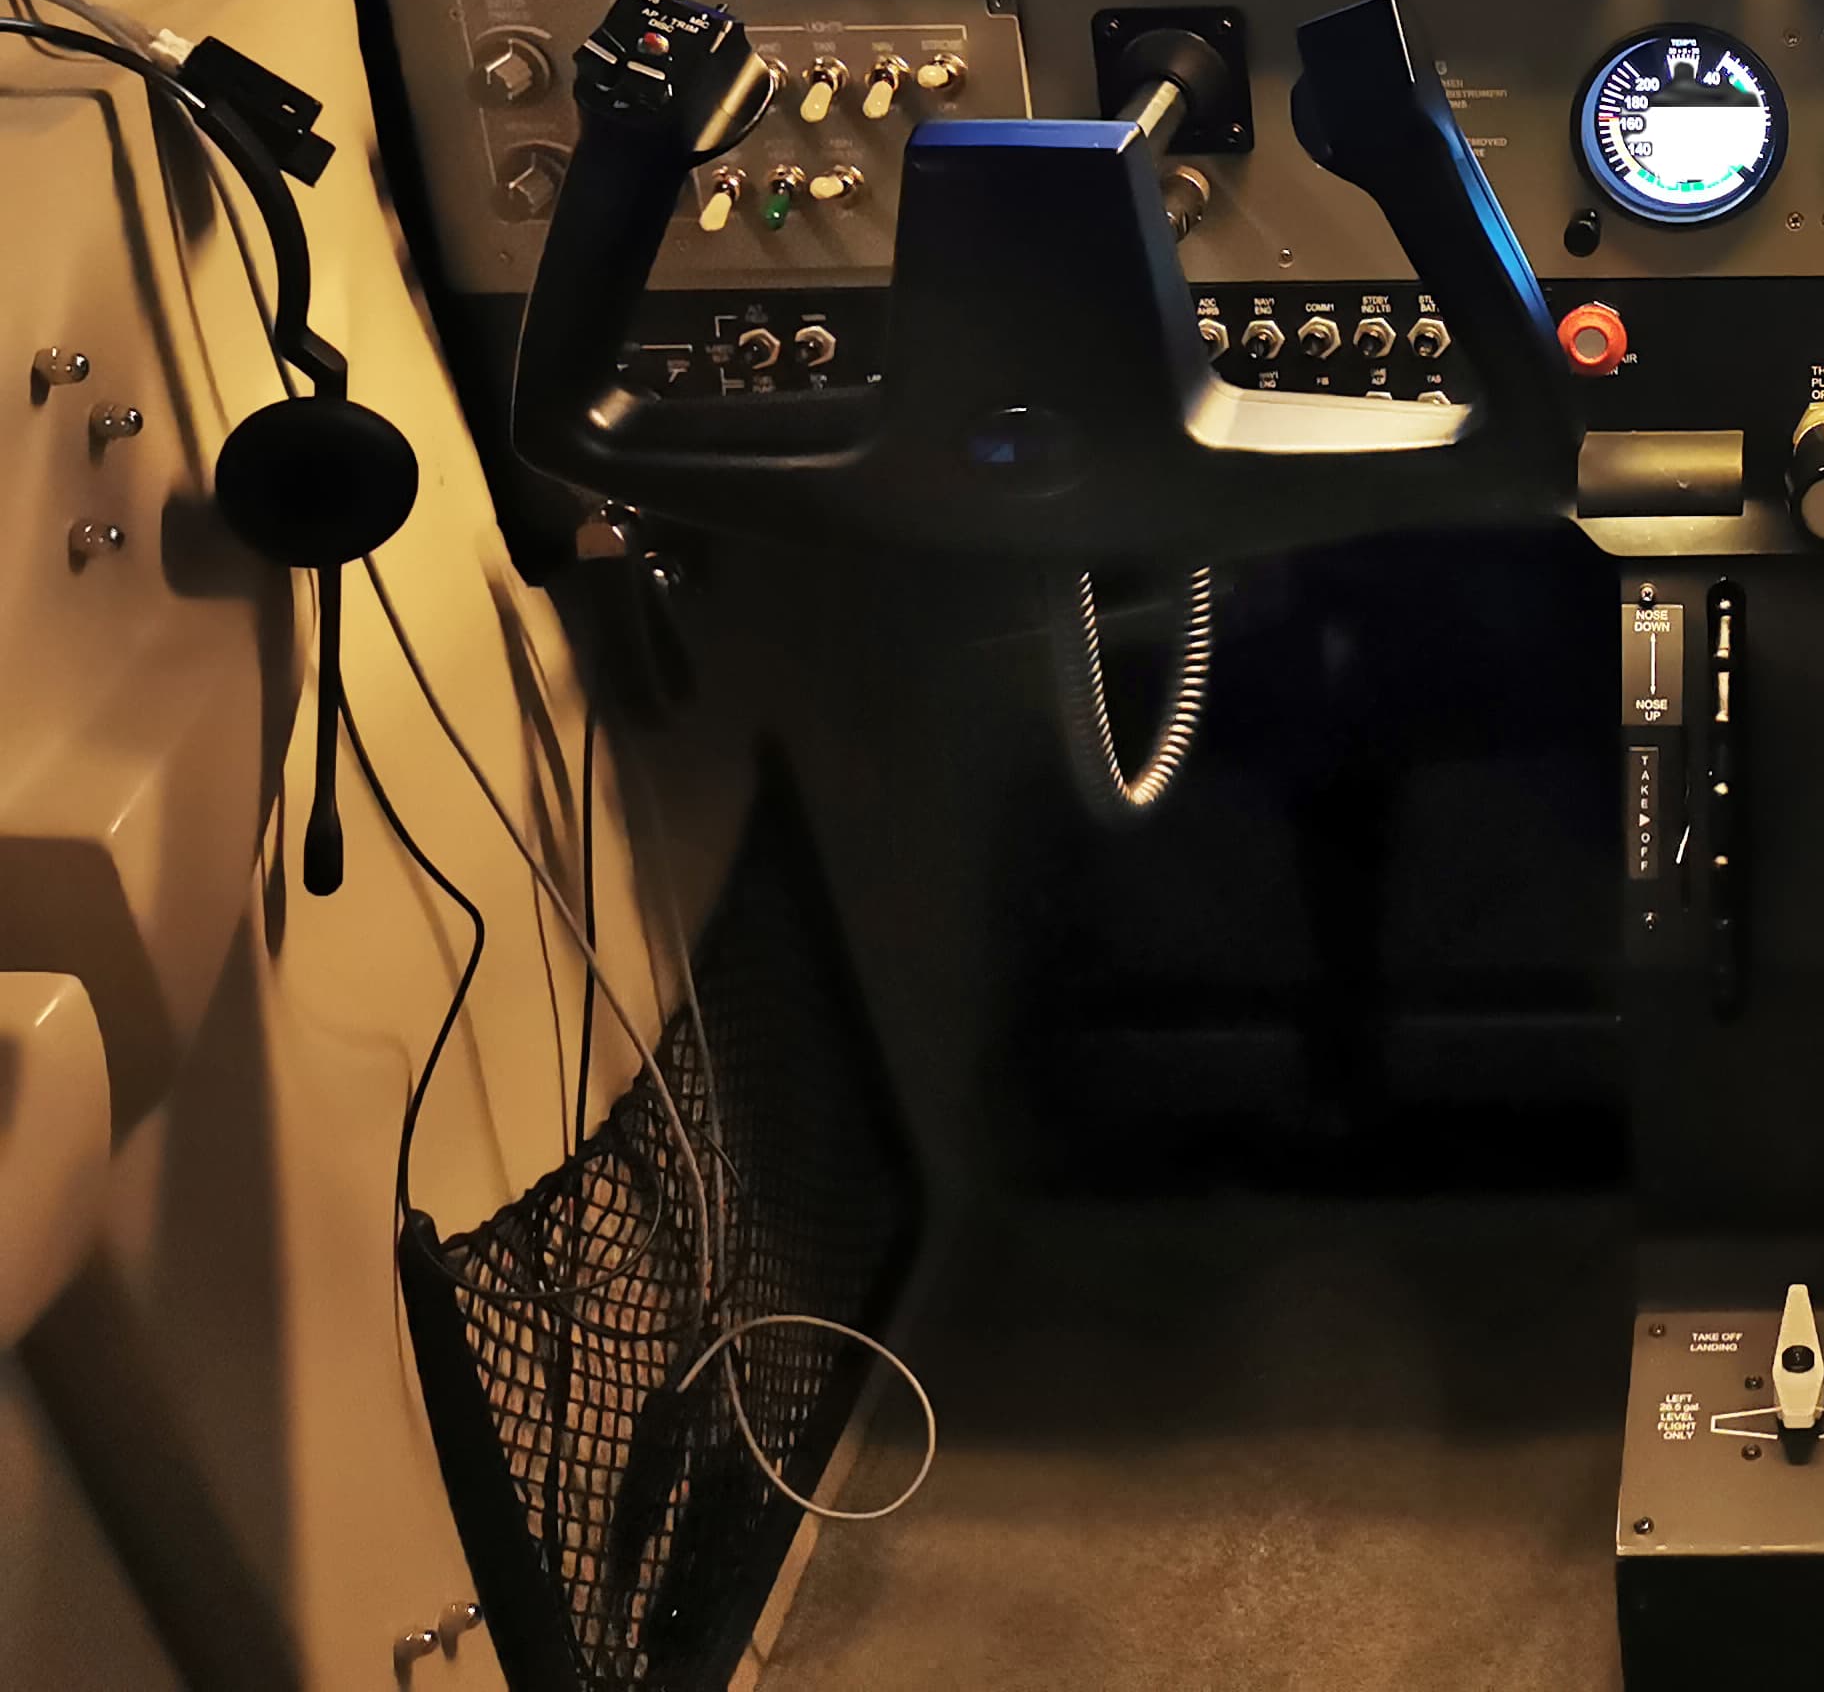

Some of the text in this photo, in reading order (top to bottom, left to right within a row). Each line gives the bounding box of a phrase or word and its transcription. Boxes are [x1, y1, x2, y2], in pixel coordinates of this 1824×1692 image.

[642, 8, 699, 33] AP TRIM
[690, 16, 710, 29] MIC
[648, 20, 674, 33] DISC
[1635, 77, 1660, 91] 200
[1703, 72, 1720, 85] 40
[1624, 97, 1648, 109] 180
[1621, 117, 1644, 130] 160
[1628, 142, 1651, 156] 140
[1199, 299, 1216, 308] ADC
[1305, 303, 1335, 312] COMM1
[1636, 610, 1668, 620] NOSE
[1634, 621, 1670, 632] DOWN
[1636, 699, 1668, 710] NOSE
[1645, 710, 1661, 721] UP
[1640, 755, 1649, 809] TAKE
[1692, 1333, 1743, 1341] TAKE OFF
[1690, 1343, 1738, 1351] LANDING
[1666, 1394, 1692, 1402] LEFT
[1683, 1403, 1699, 1412] gal
[1661, 1413, 1694, 1421] LEVEL
[1658, 1422, 1696, 1430] FLIGHT
[1663, 1431, 1694, 1439] ONLY
